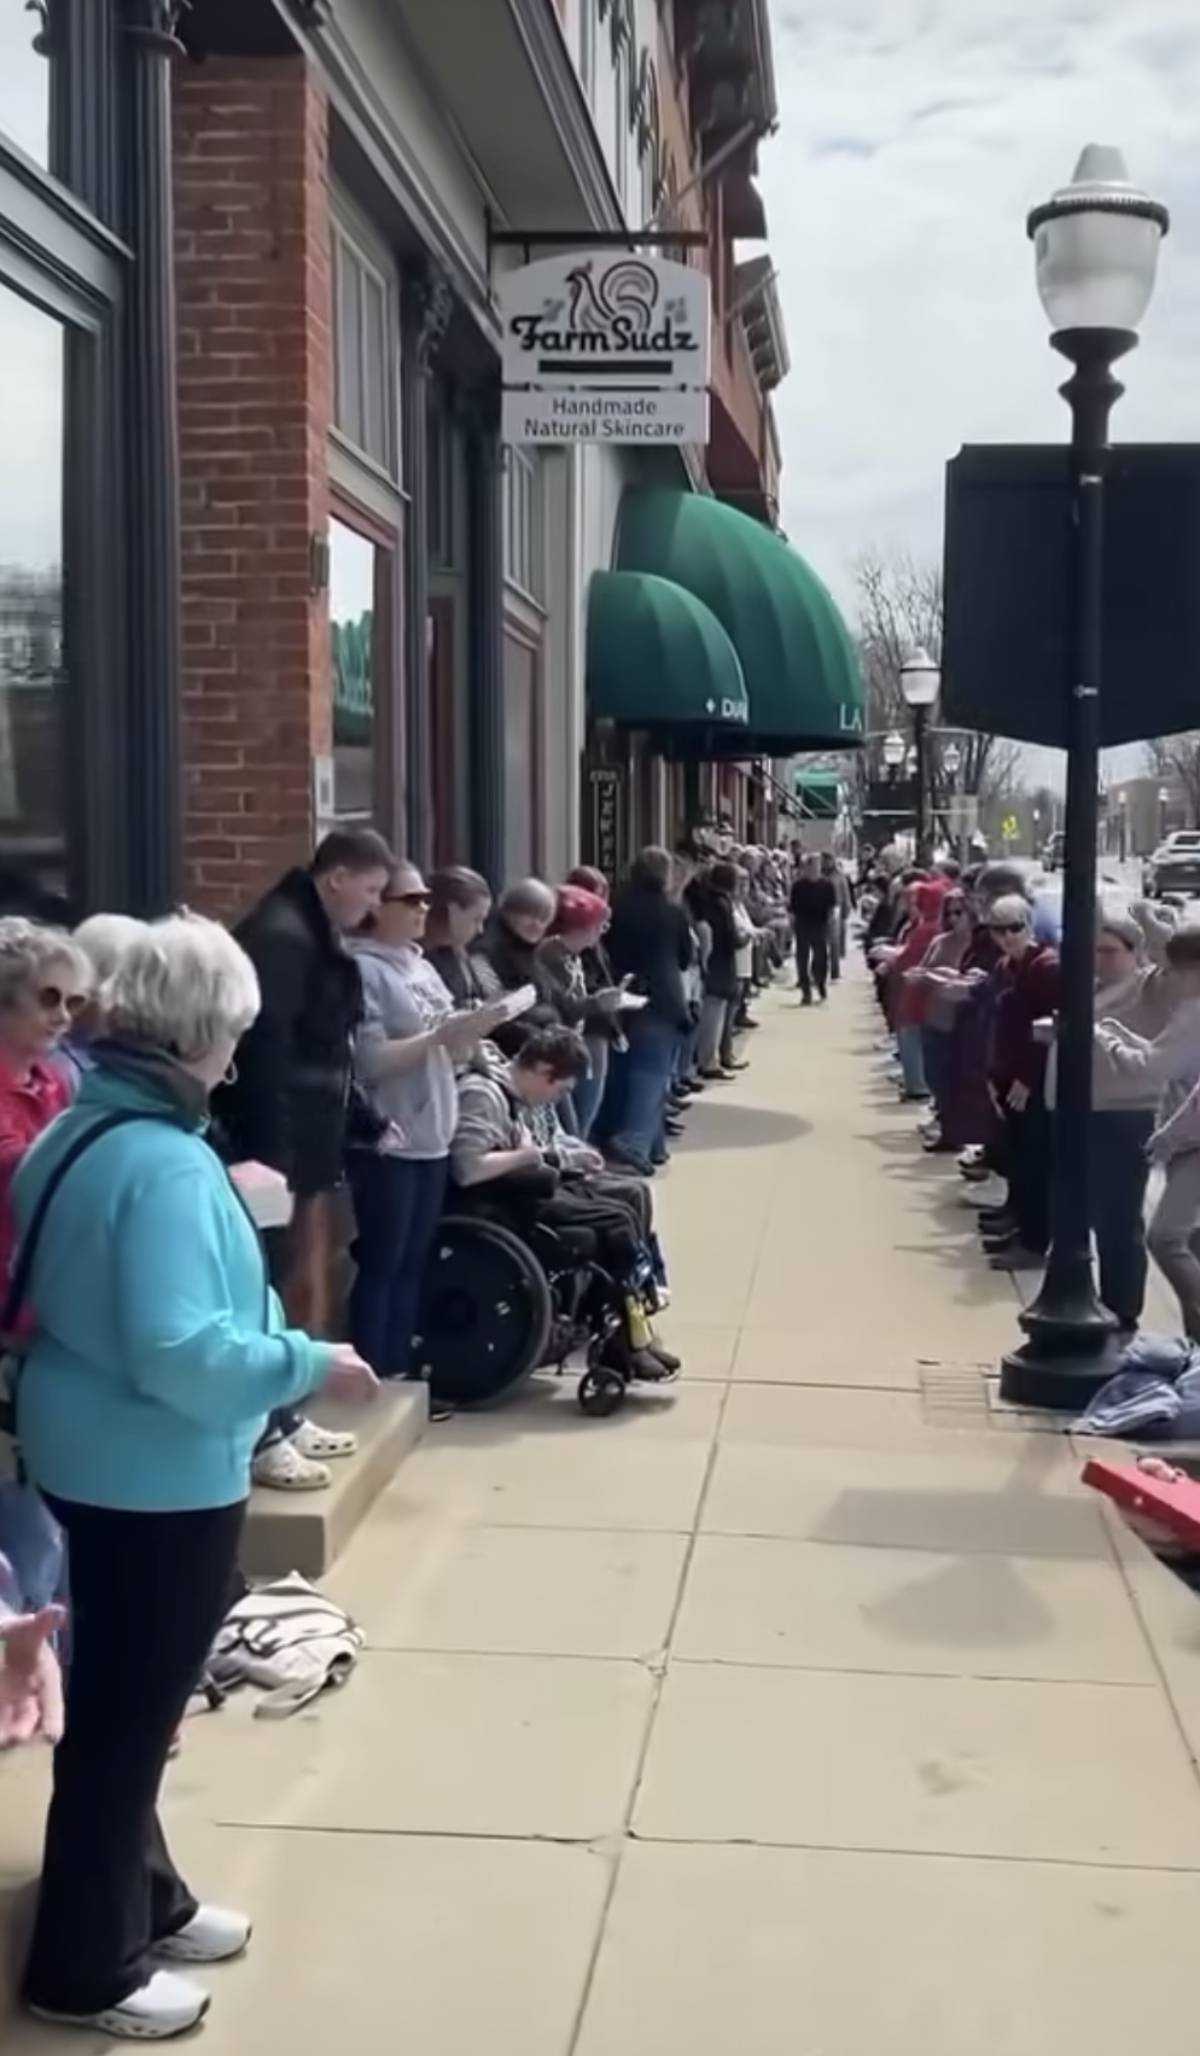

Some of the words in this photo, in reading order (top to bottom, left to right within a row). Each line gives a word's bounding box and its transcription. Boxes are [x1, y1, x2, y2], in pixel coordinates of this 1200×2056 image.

[510, 315, 699, 351] FarmSudz
[553, 398, 657, 416] Handmade
[524, 418, 597, 438] Natural
[602, 418, 685, 438] Skincare
